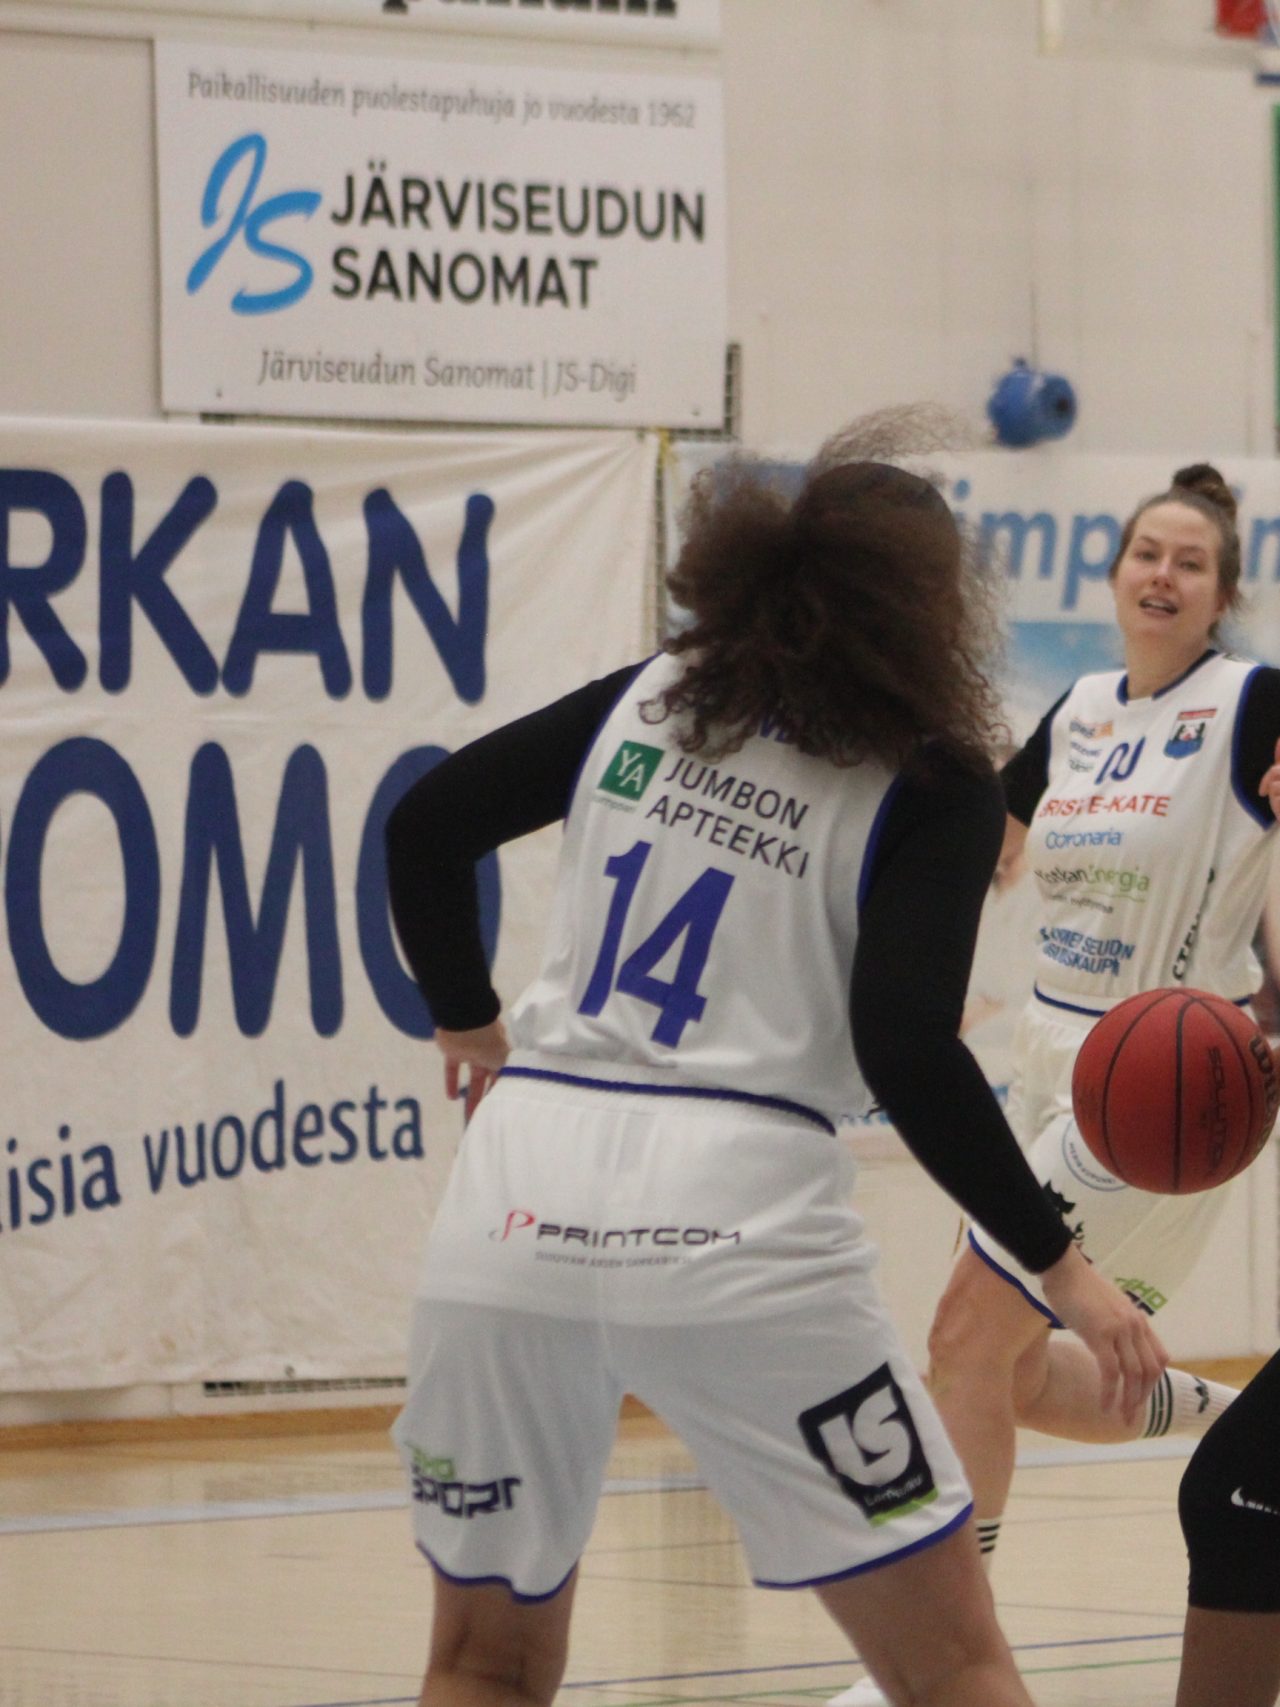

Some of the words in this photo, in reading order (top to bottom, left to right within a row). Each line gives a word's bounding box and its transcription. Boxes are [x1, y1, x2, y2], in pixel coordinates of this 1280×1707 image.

[188, 71, 345, 110] Paikallisuuden
[352, 81, 516, 122] puolestapuhuja
[520, 95, 543, 126] jo
[548, 97, 641, 126] vuodesta
[647, 101, 697, 130] 1962
[330, 159, 706, 243] JÄRVISEUDUN
[330, 247, 599, 310] SANOMAT
[258, 348, 416, 387] Järviseudun
[423, 353, 535, 392] Sanomat
[552, 360, 638, 396] JS-Digi
[664, 757, 809, 830] JUMBON
[645, 795, 809, 878] APTEEKKI
[577, 840, 735, 1049] 14
[0, 1124, 122, 1231] isia
[142, 1078, 425, 1195] vuodesta
